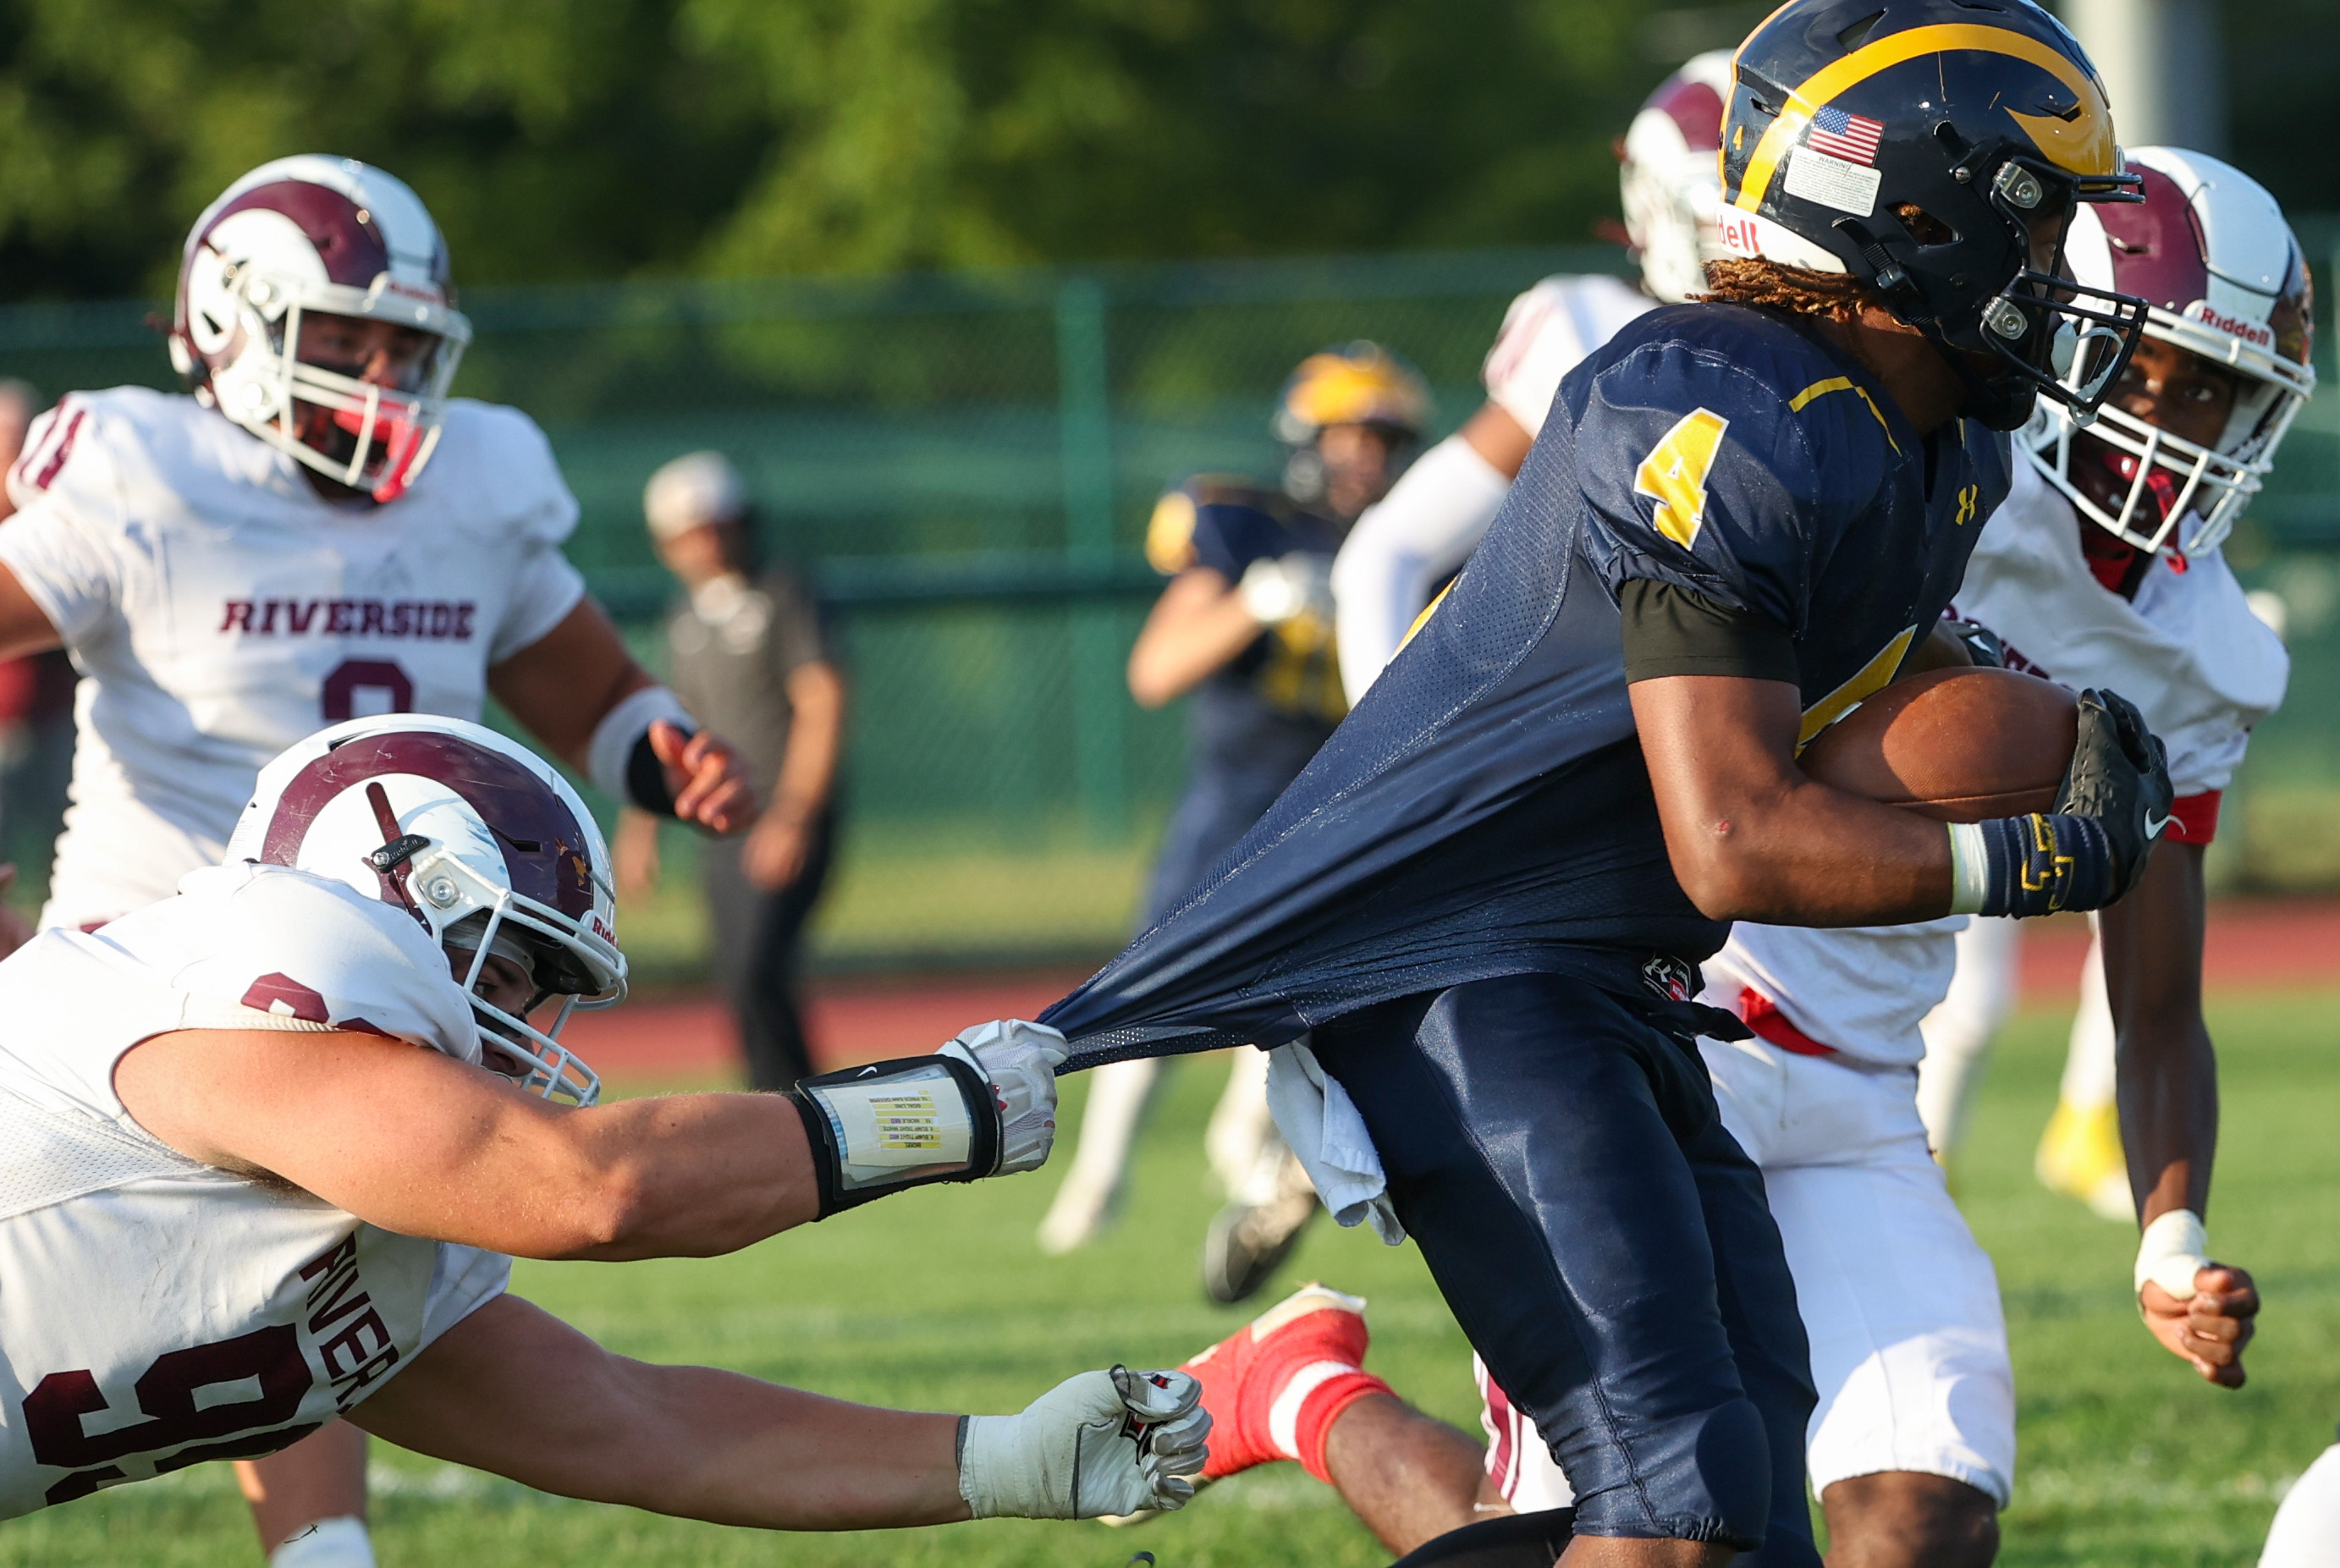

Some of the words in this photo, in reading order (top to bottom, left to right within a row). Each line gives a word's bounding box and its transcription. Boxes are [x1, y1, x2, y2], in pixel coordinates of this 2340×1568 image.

[1732, 125, 1744, 151] 4
[2201, 305, 2270, 346] Riddell
[1633, 406, 1730, 552] 4
[219, 599, 476, 641] RIVERSIDE
[299, 1231, 399, 1416] RIVER
